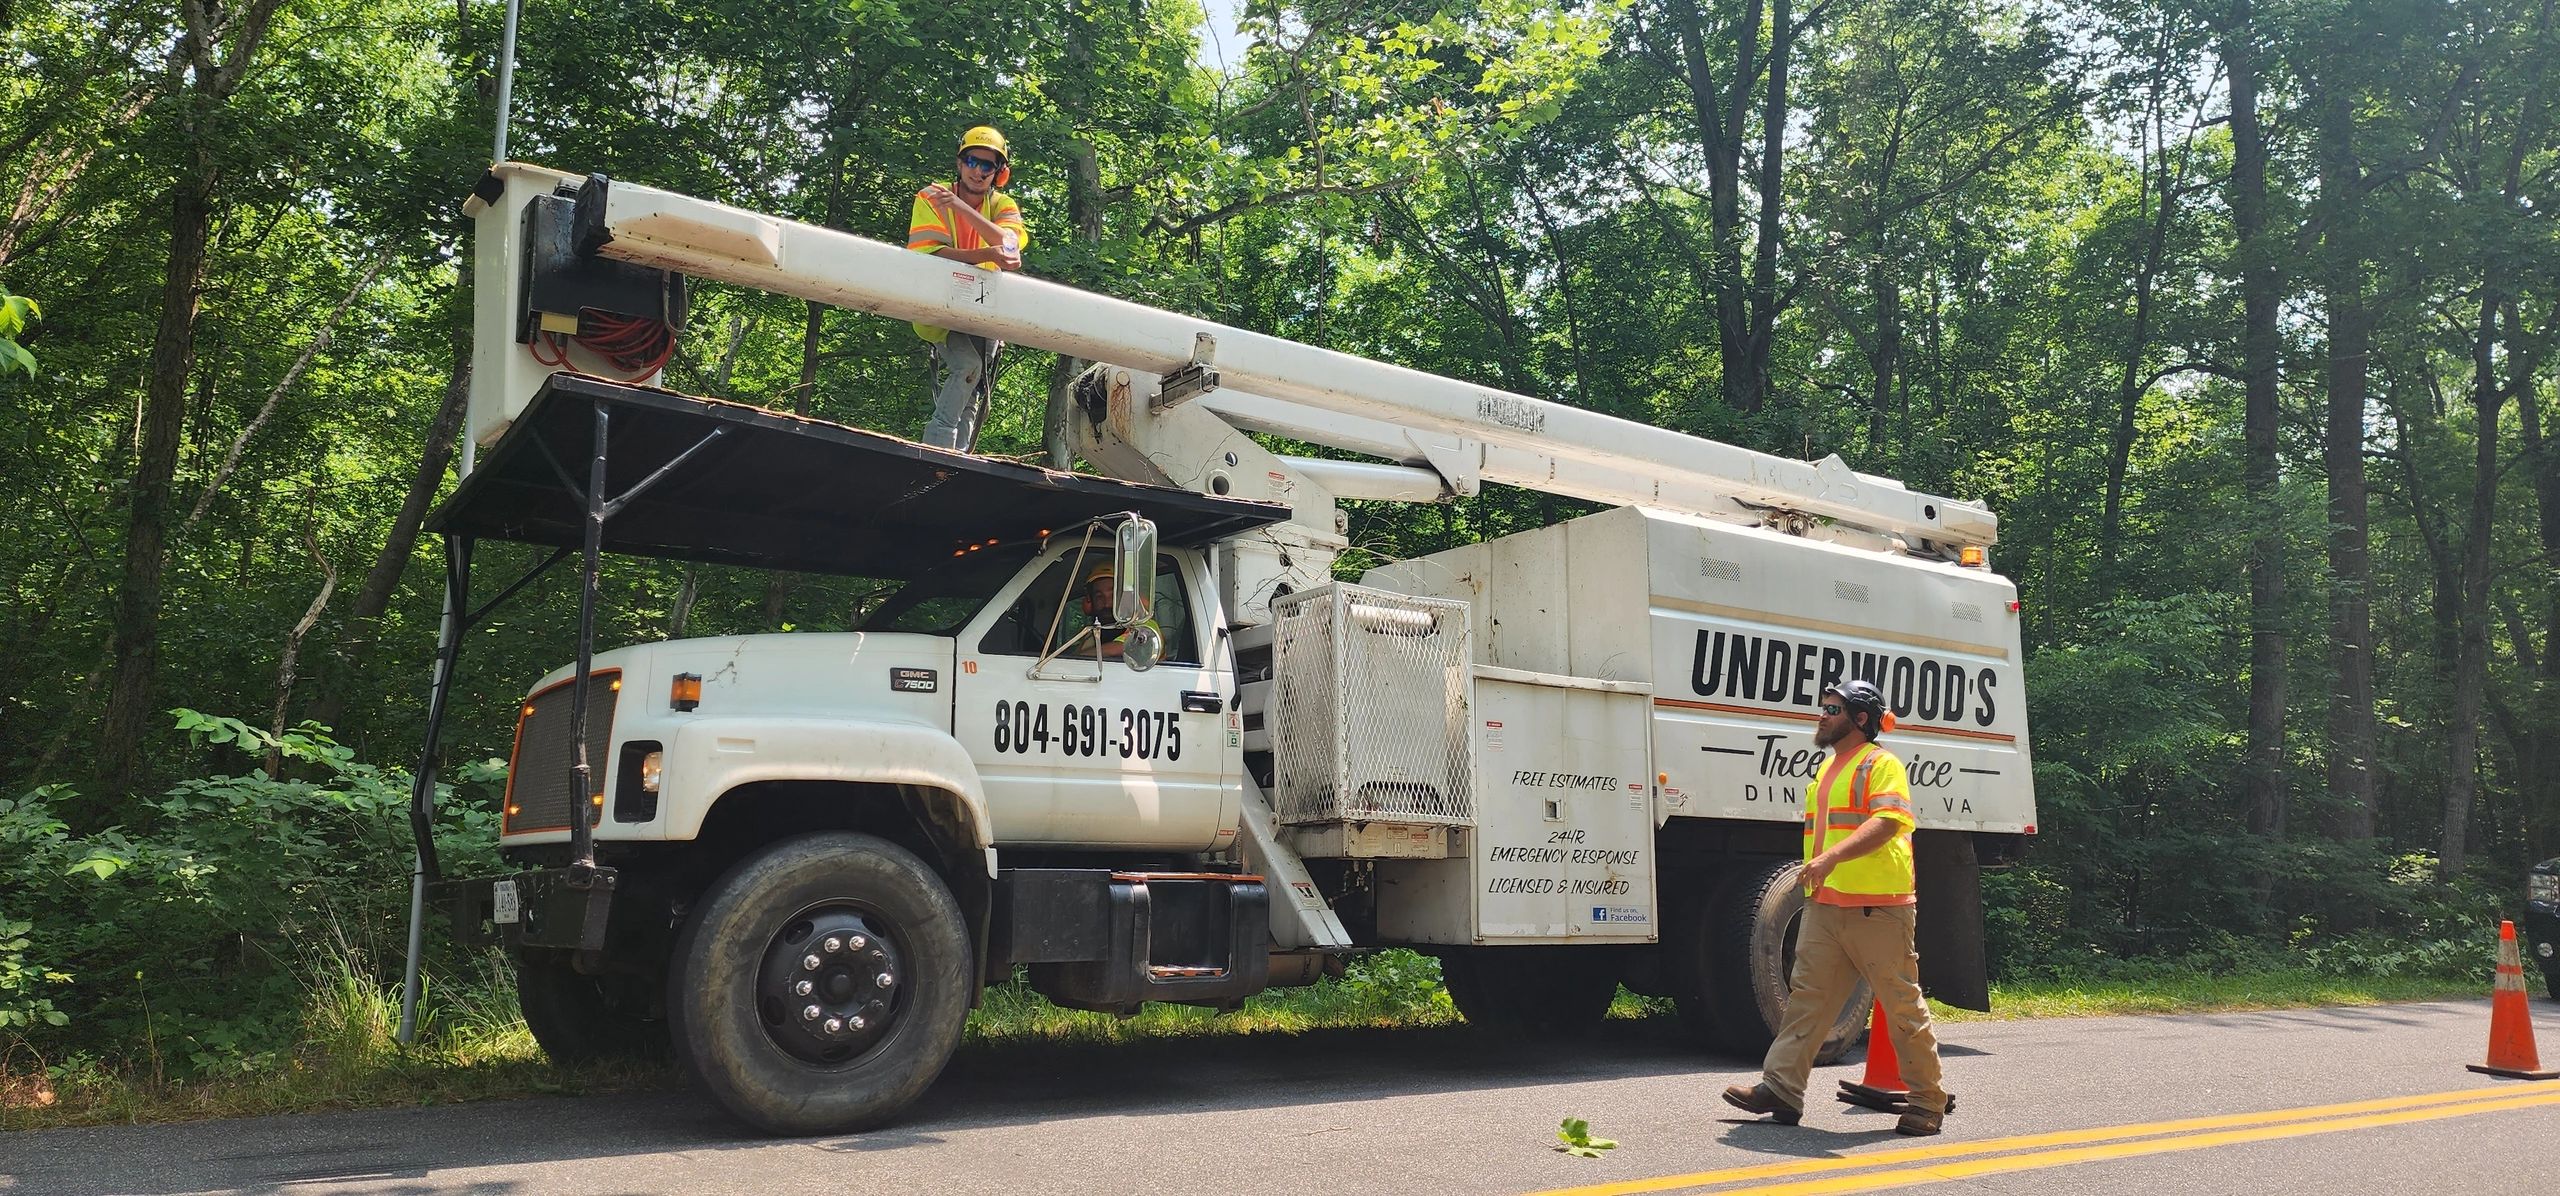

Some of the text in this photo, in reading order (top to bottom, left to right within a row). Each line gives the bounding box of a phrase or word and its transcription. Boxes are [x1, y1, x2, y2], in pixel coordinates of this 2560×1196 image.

[900, 670, 929, 679] GMC
[962, 661, 977, 674] 10
[895, 680, 935, 690] C7500
[994, 699, 1181, 761] 804-691-3075
[1757, 734, 1826, 779] Tree
[1512, 770, 1617, 791] FREE ESTIMATES
[1943, 797, 1972, 814] VA
[1548, 829, 1586, 844] 24HR
[1490, 846, 1639, 865] EMERGENCY RESPONSE
[1488, 877, 1630, 895] LICENSED & INSURED
[1610, 914, 1647, 922] Facebook
